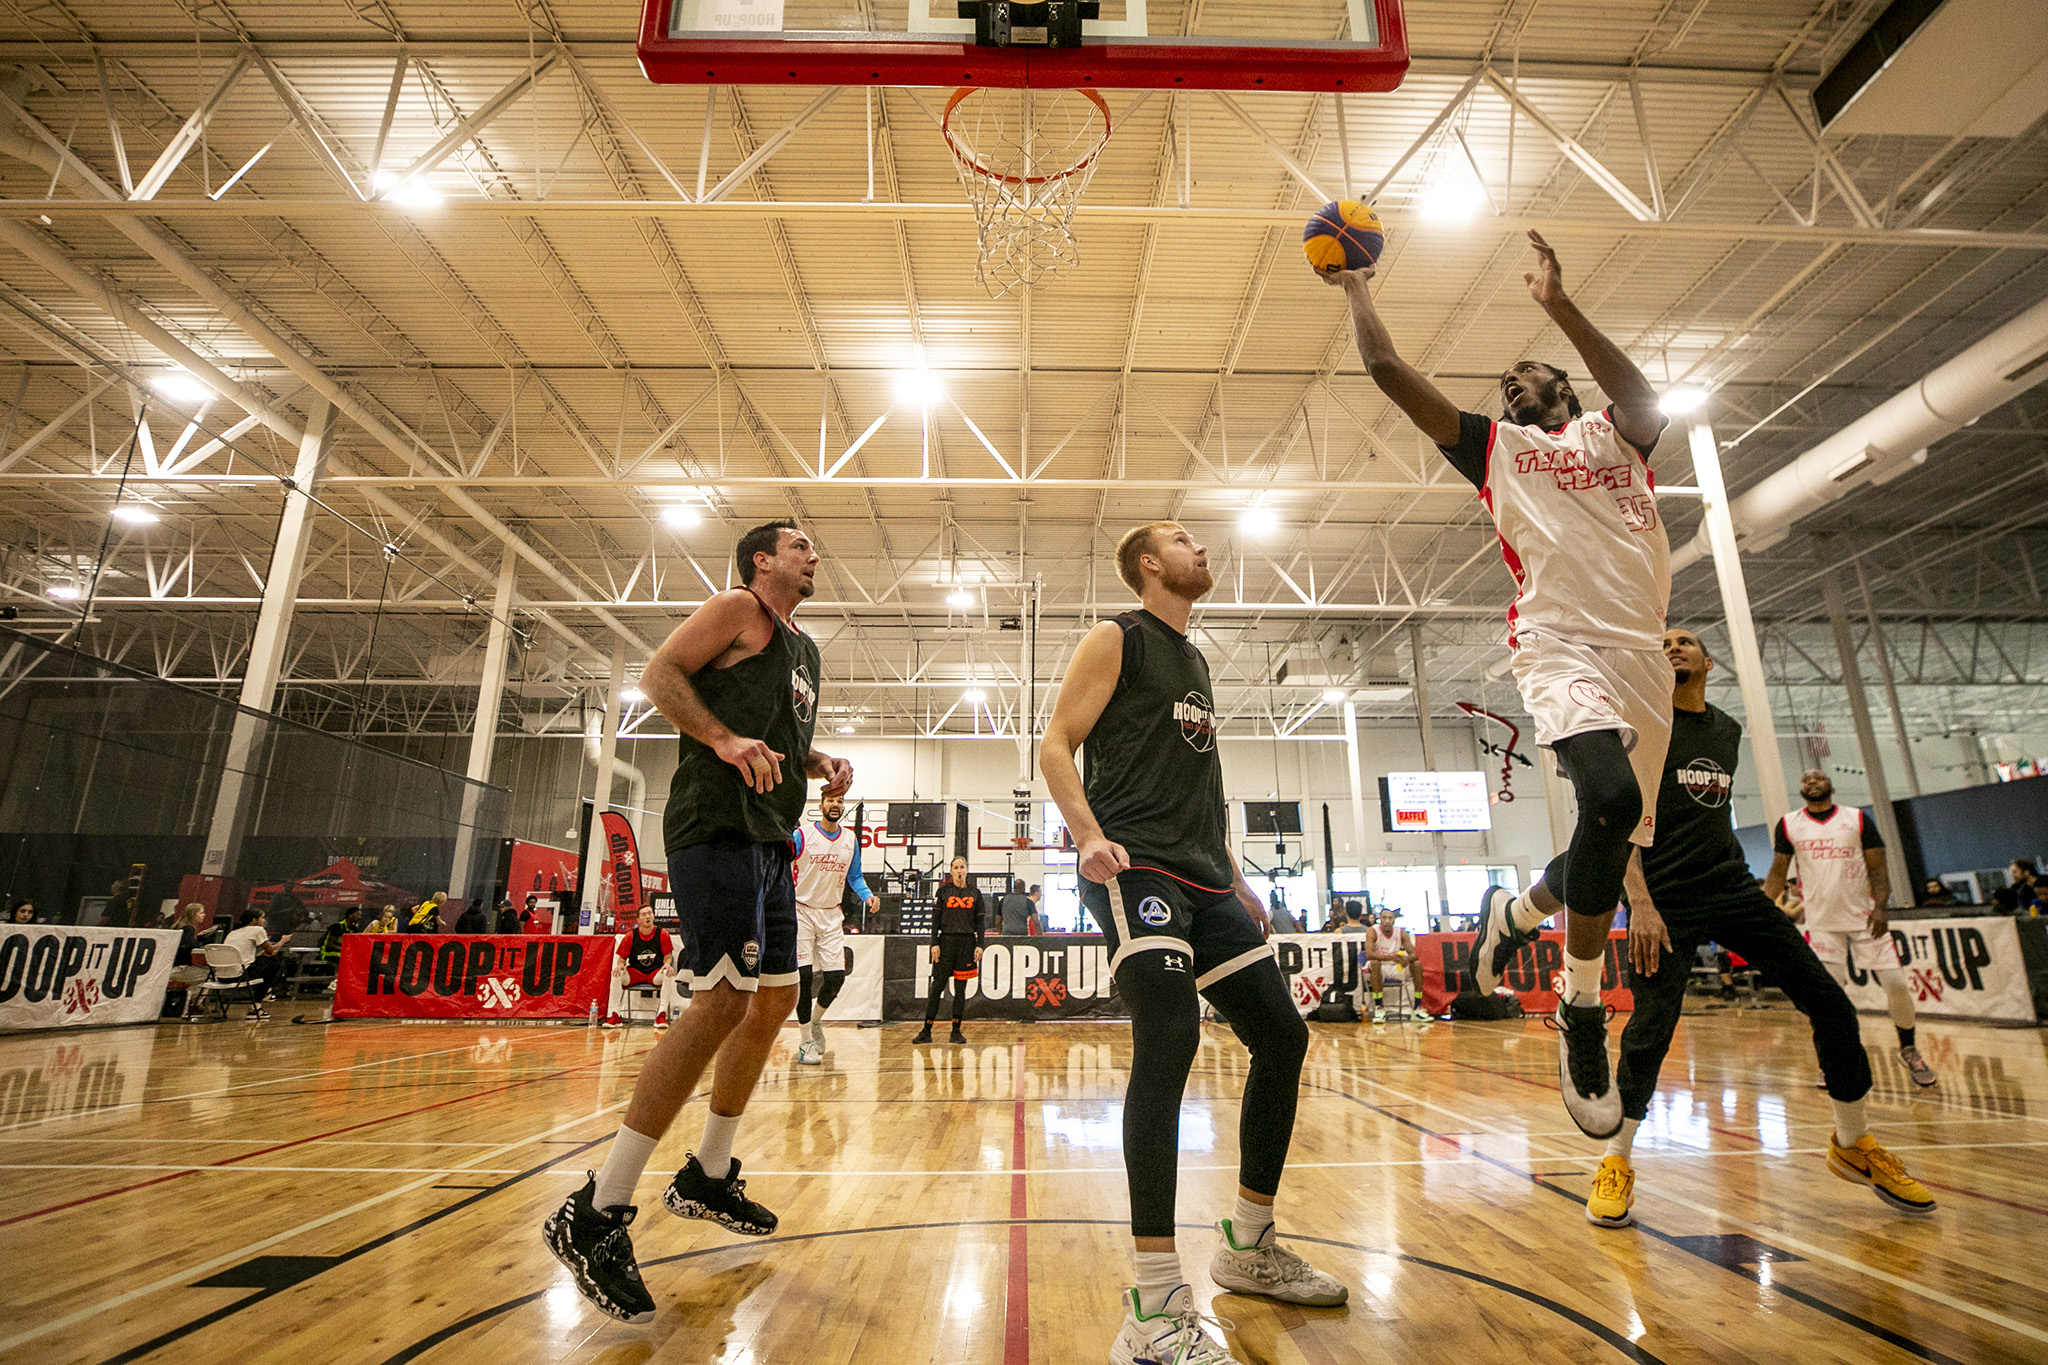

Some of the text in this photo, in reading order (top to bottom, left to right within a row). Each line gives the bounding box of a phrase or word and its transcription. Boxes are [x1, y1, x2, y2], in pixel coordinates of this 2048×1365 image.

[1515, 449, 1587, 474] TEAM
[1554, 464, 1632, 491] PEACE
[1173, 701, 1202, 725] HOOP
[1677, 768, 1711, 786] HOOP
[1718, 773, 1731, 789] UP
[1399, 811, 1427, 821] RAFFLE
[610, 832, 629, 854] UP
[1798, 838, 1835, 851] TEAM
[809, 853, 840, 865] TEAM
[614, 862, 635, 906] HOOP
[86, 943, 109, 969] IT
[102, 937, 157, 999] UP
[366, 940, 584, 997] HOOP IT UP
[1042, 950, 1065, 974] IT
[1308, 947, 1328, 969] IT
[1912, 935, 1929, 960] IT
[1932, 927, 1992, 991] UP
[477, 977, 521, 1009] 3X3
[1026, 977, 1067, 1007] 3X3
